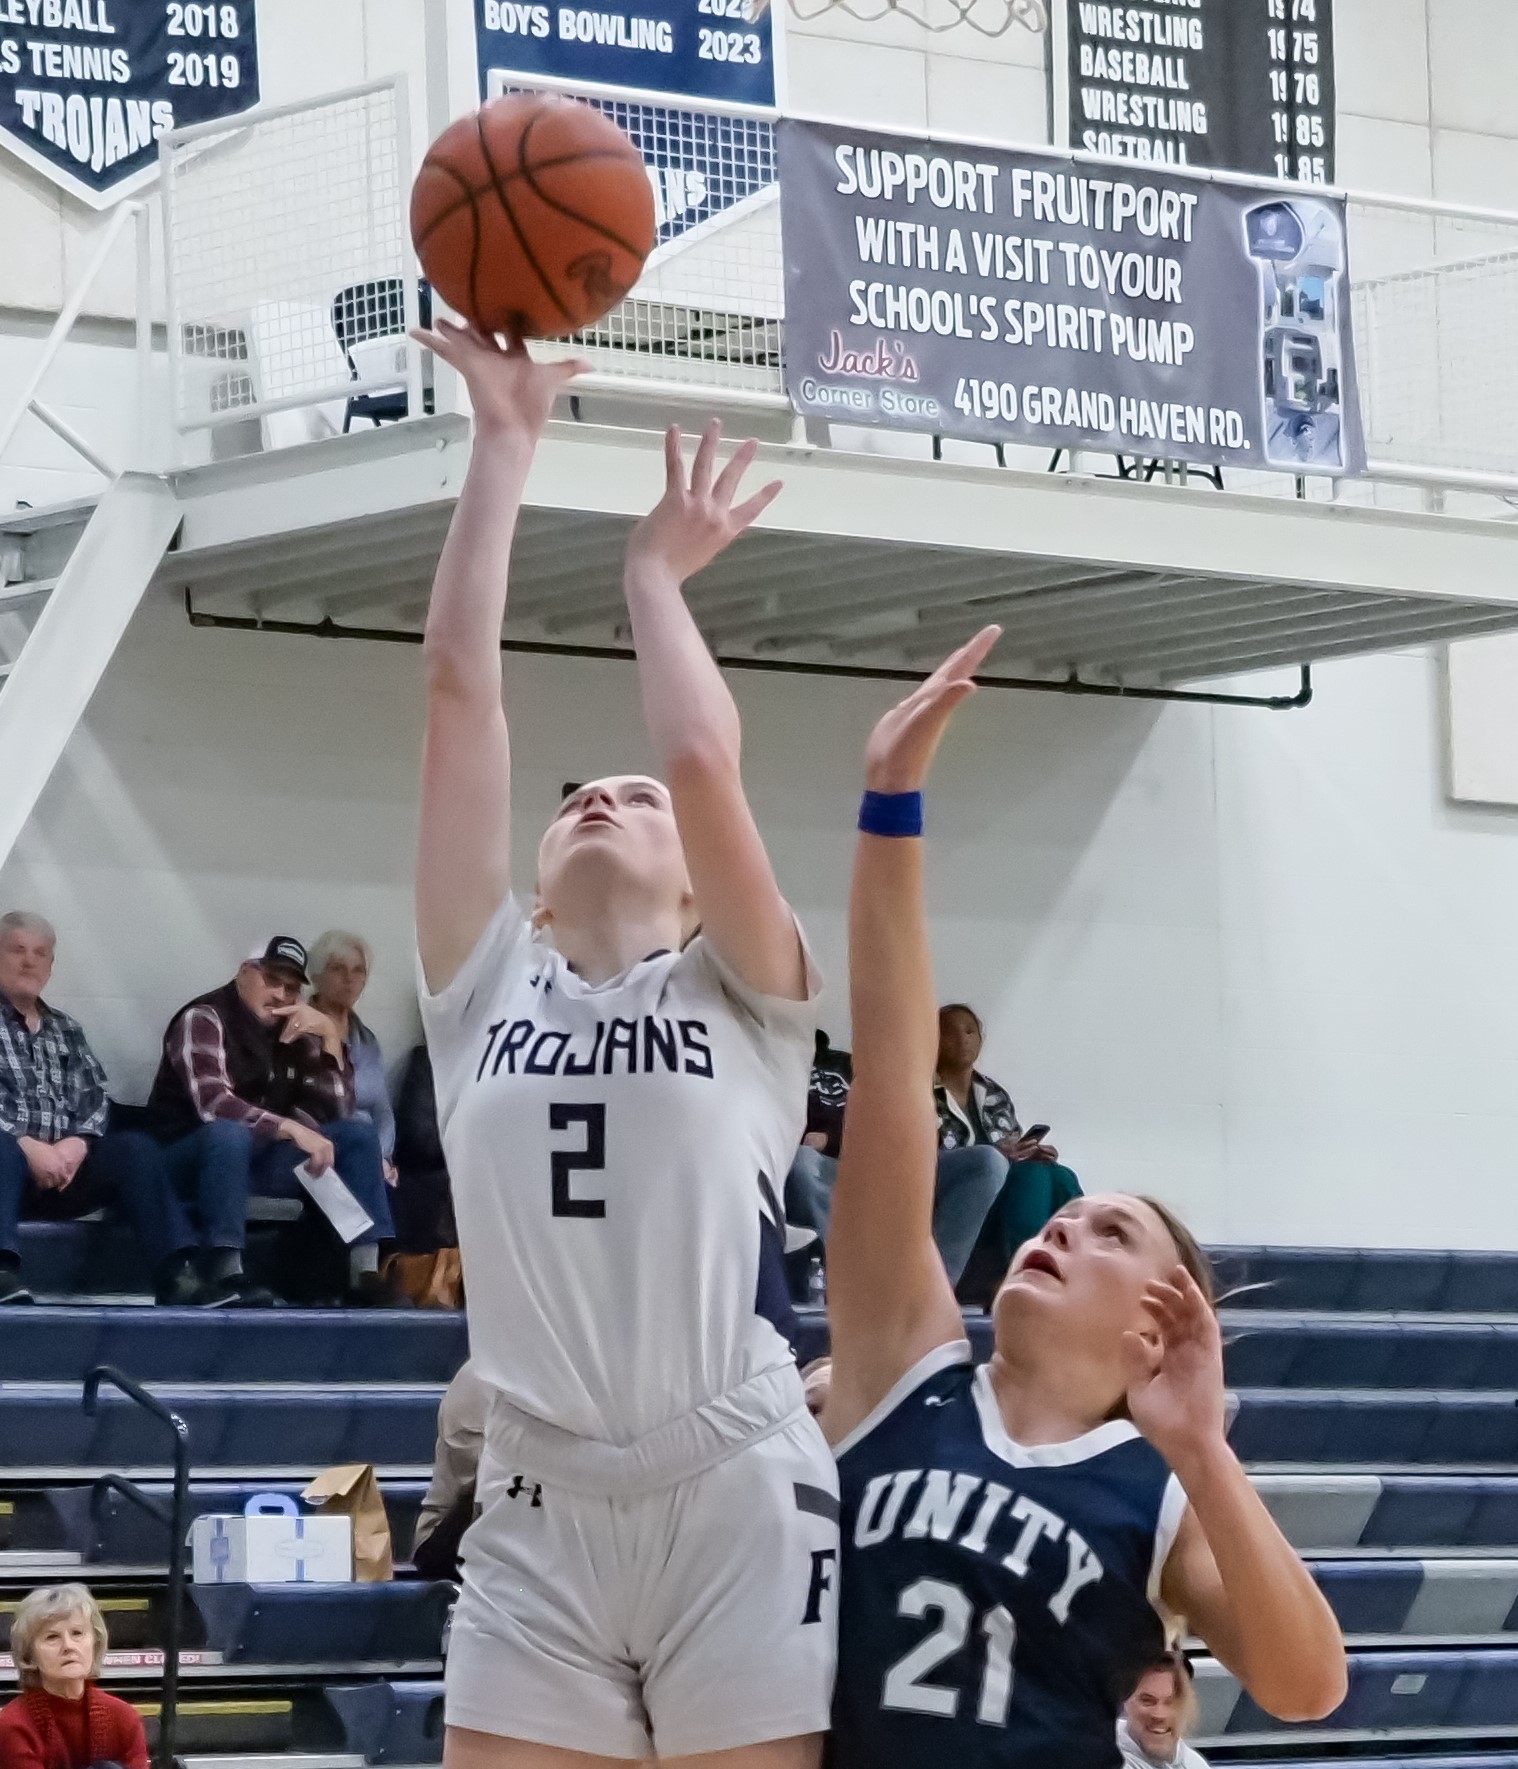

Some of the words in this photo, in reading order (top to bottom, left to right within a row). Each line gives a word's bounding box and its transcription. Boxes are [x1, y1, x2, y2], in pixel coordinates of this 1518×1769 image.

[166, 3, 239, 38] 2018
[484, 0, 550, 38] BOYS
[558, 8, 673, 53] BOWLING
[698, 28, 761, 64] 2023
[1078, 2, 1203, 50] WRESTLING
[26, 41, 130, 83] TENNIS
[167, 52, 240, 88] 2019
[1080, 44, 1190, 90] BASEBALL
[15, 89, 175, 174] TROJANS
[1080, 87, 1208, 135] WRESTLING
[834, 144, 999, 214] SUPPORT
[1011, 168, 1198, 242] FRUITPORT
[1274, 153, 1325, 184] 185
[855, 215, 939, 270] WITH
[945, 228, 968, 275] A
[971, 231, 1054, 284] VISIT
[1058, 242, 1099, 290] TO
[1099, 249, 1182, 304] YOUR
[818, 330, 919, 382] Jack's
[849, 279, 999, 341] SCHOOL'S
[1004, 298, 1106, 353] SPIRIT
[1109, 312, 1195, 366] PUMP
[801, 377, 872, 410] Corner
[880, 388, 940, 417] Store
[954, 377, 1018, 422] 4190
[1022, 384, 1116, 432] GRAND
[1119, 396, 1206, 444] HAVEN
[1209, 407, 1251, 449] RD.
[476, 1015, 714, 1083] TROJANS
[549, 1103, 606, 1218] 2
[854, 1468, 1104, 1627] UNITY
[800, 1548, 836, 1625] F
[880, 1575, 1018, 1728] 21
